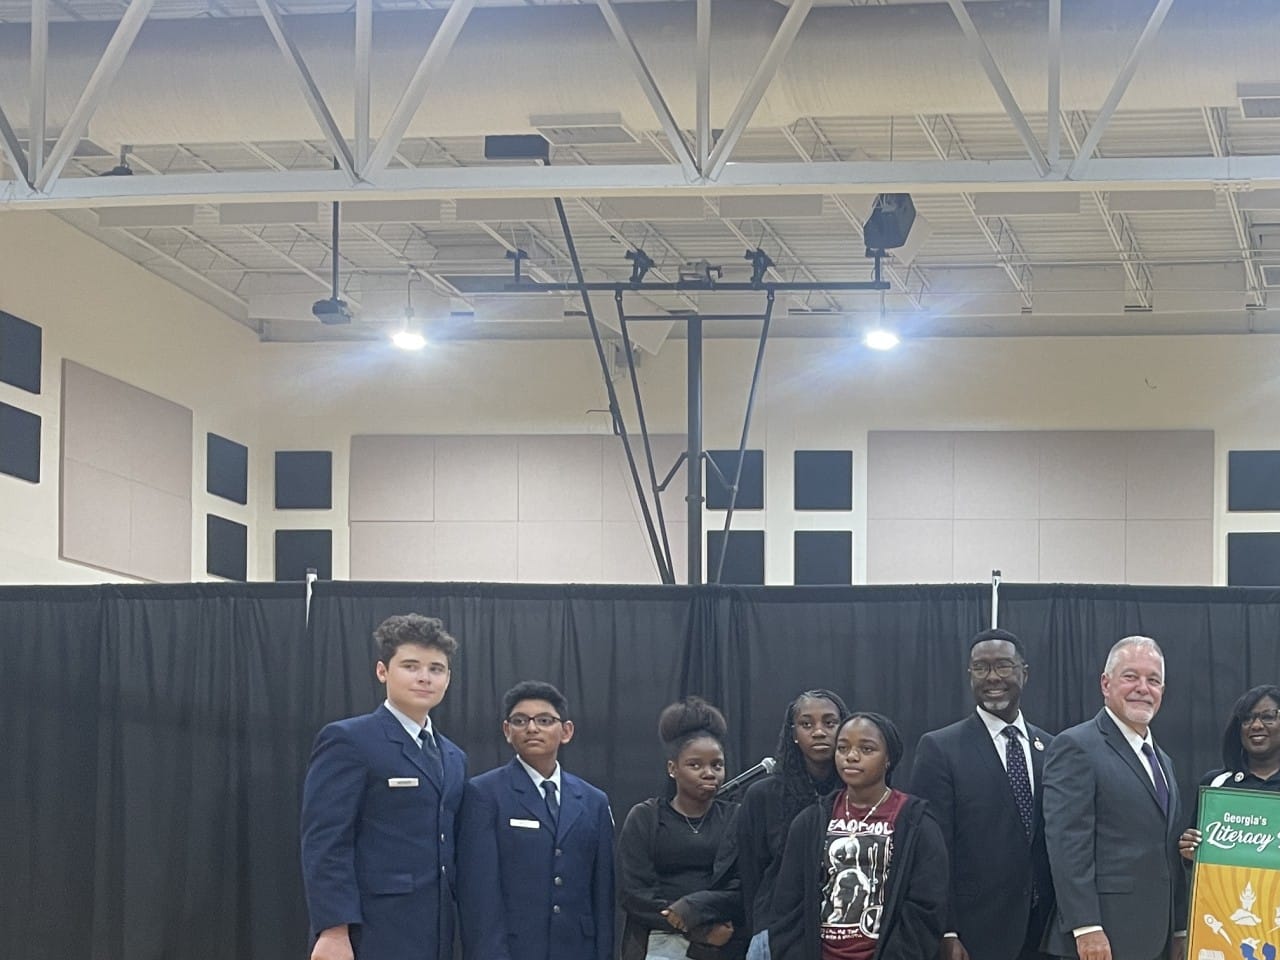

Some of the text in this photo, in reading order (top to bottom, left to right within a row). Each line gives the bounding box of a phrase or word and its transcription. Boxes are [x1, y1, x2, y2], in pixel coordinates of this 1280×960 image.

[827, 819, 893, 835] EADPOOL
[1224, 812, 1267, 826] Georgia's
[1206, 821, 1275, 852] Literacy
